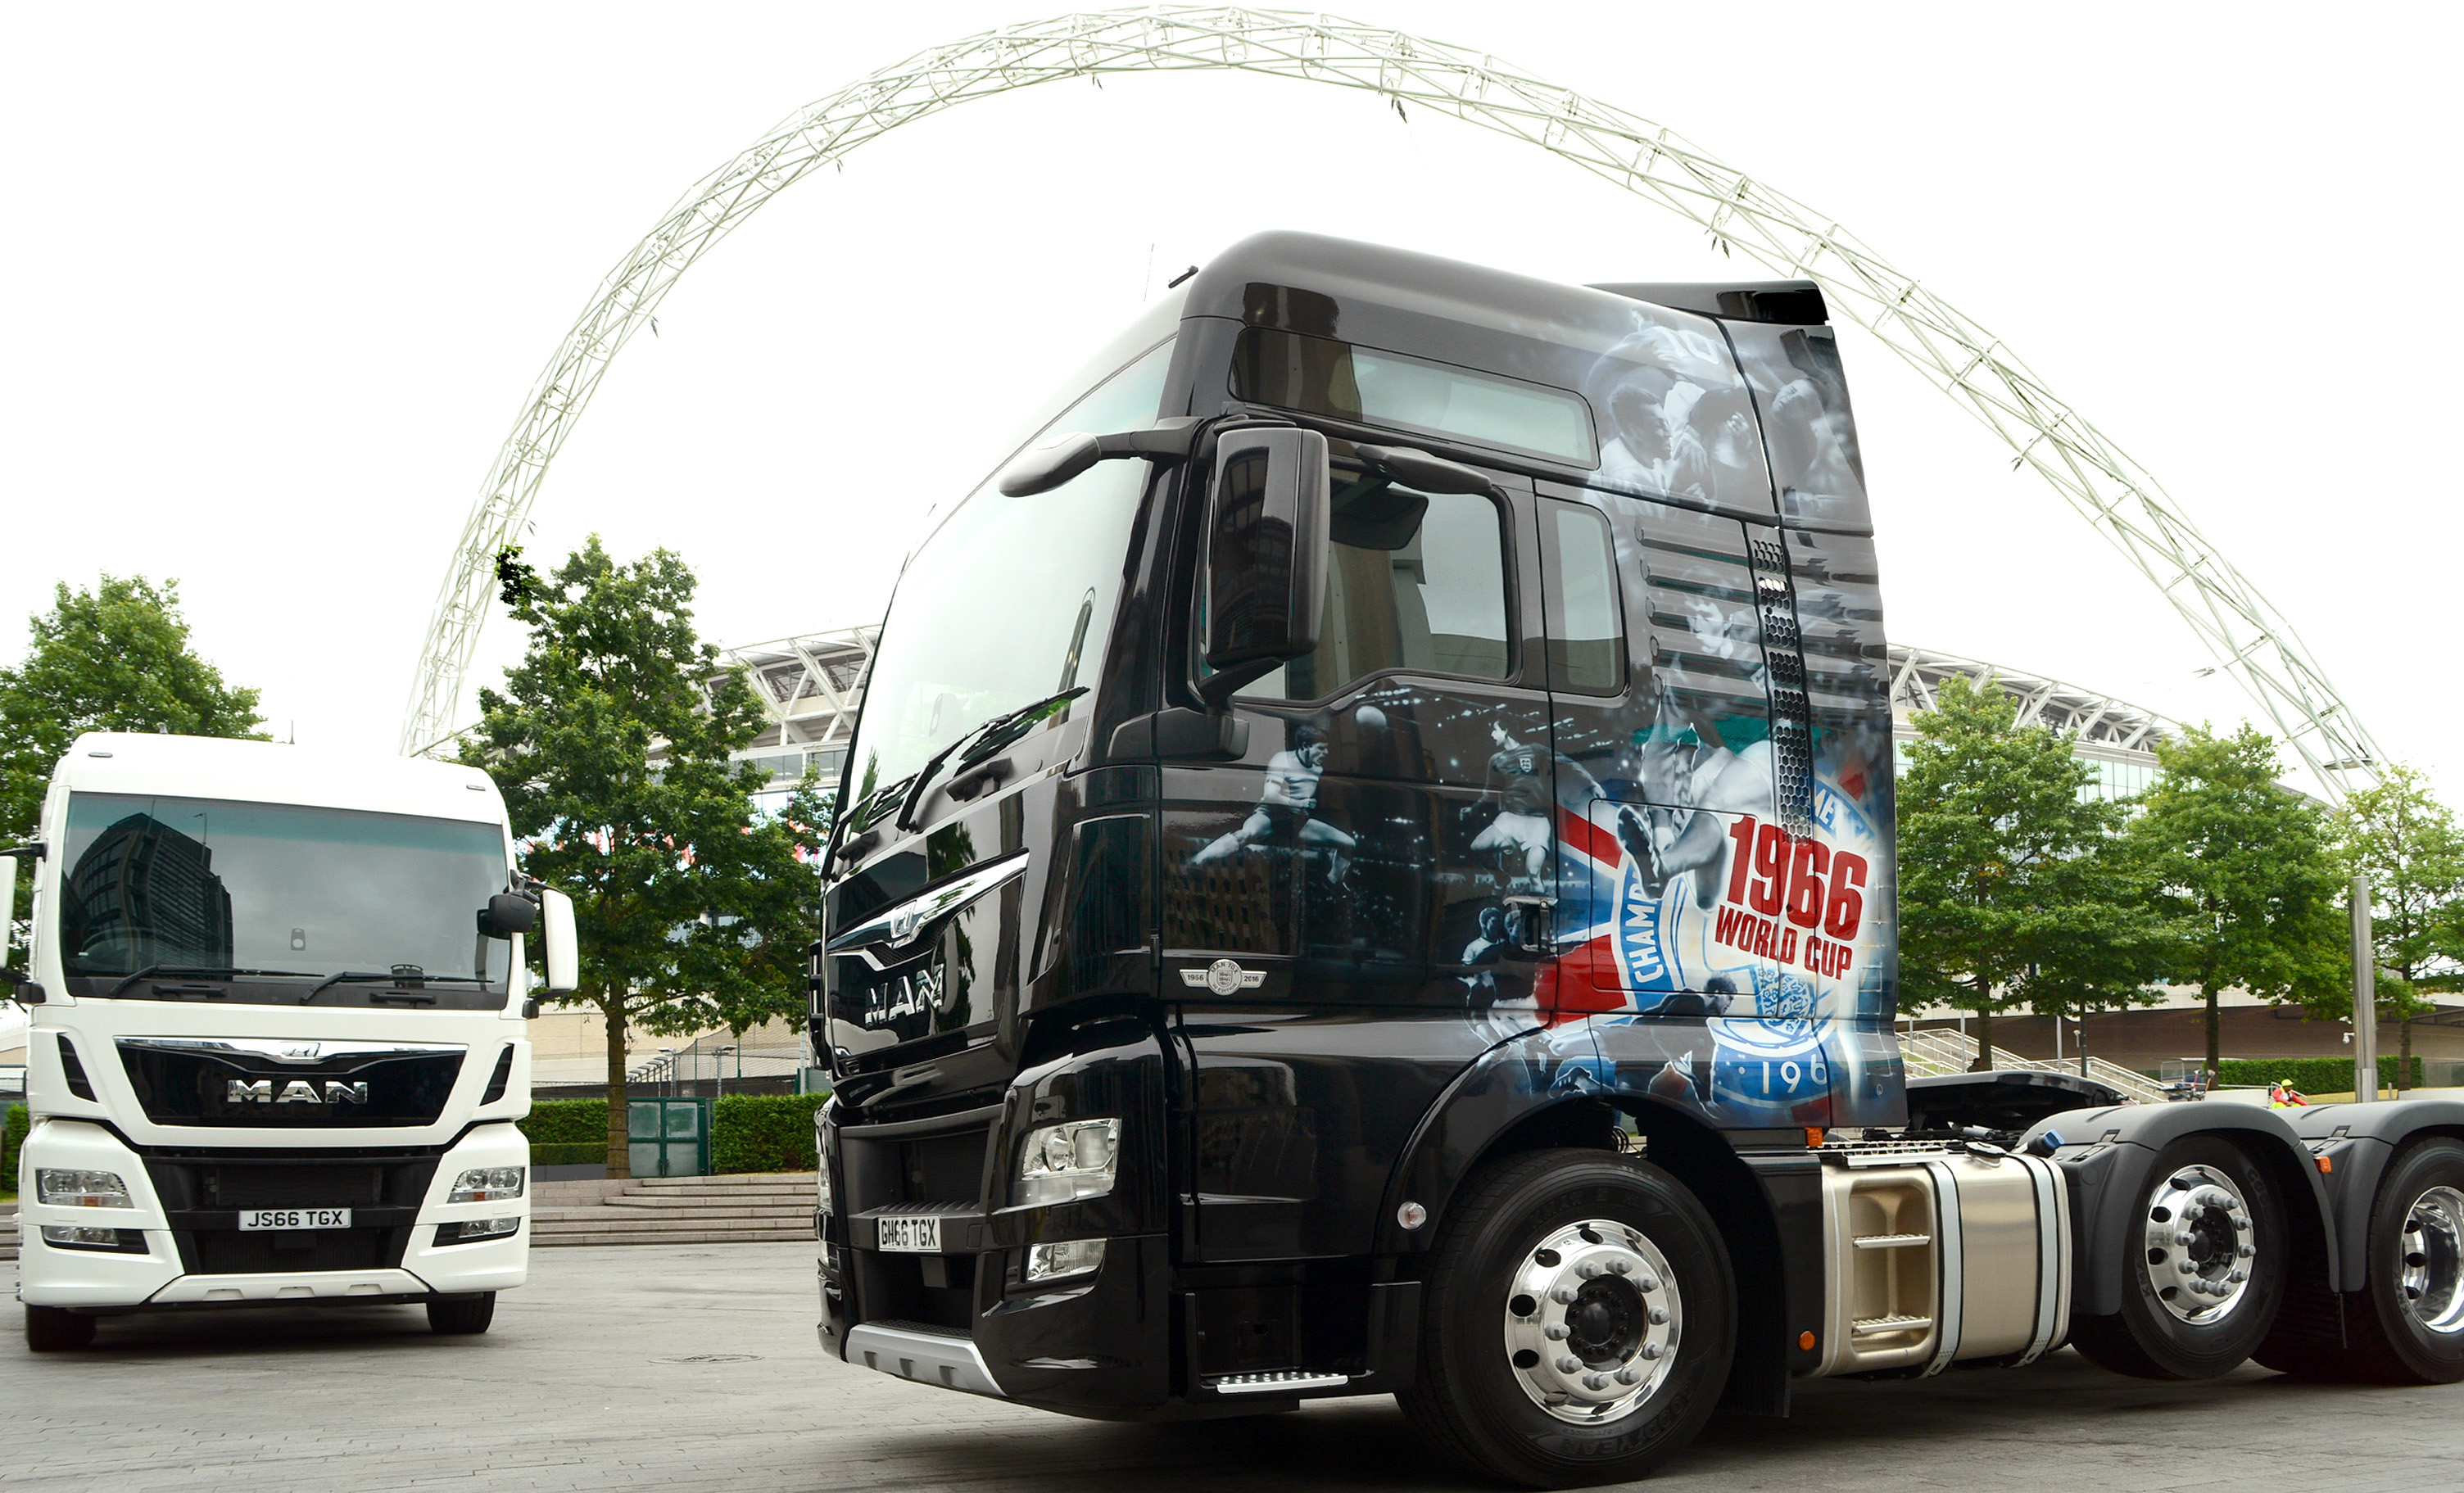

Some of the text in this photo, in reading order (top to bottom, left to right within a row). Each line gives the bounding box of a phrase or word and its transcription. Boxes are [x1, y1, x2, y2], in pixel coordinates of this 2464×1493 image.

[1727, 816, 1868, 941] 1966
[1625, 870, 1665, 983] CHAMP
[1714, 904, 1853, 980] WORLD CUP
[1211, 961, 1226, 974] MAN
[865, 963, 944, 1027] MAN
[228, 1079, 368, 1104] MAN
[247, 1210, 342, 1227] JS66 TGX
[881, 1219, 936, 1246] GH66 TGX
